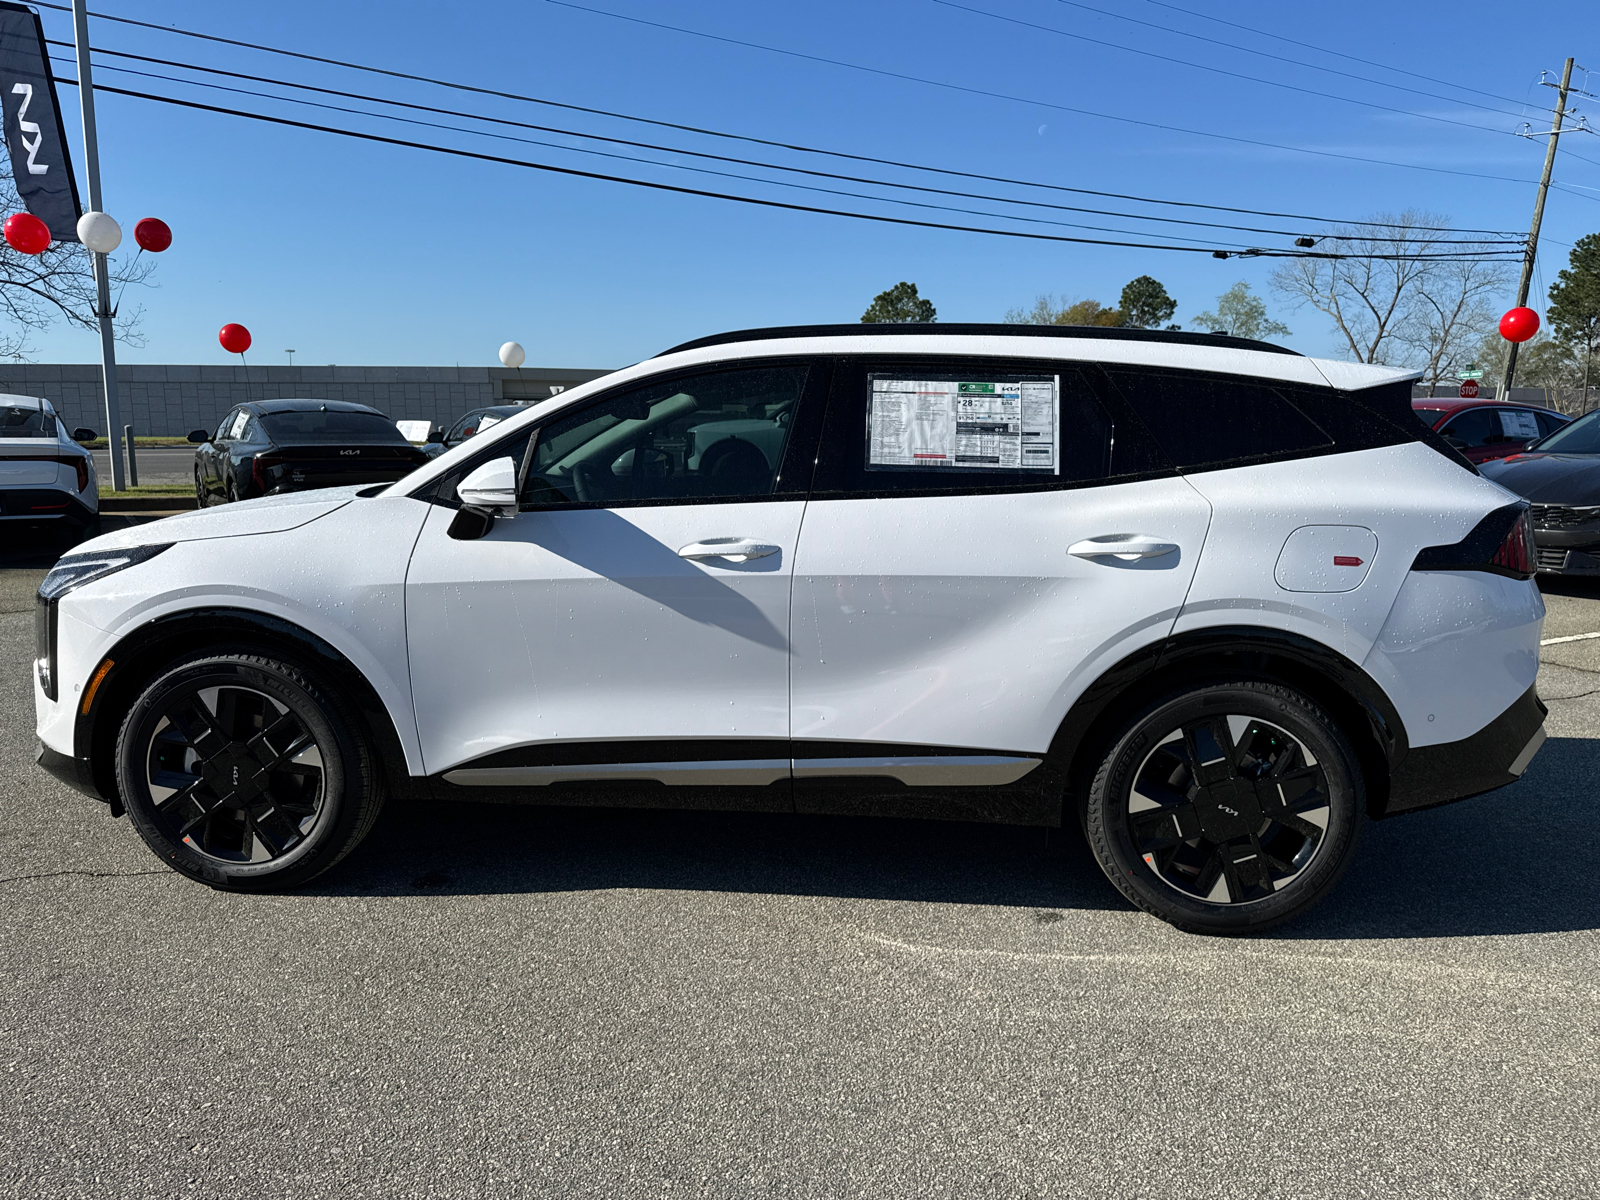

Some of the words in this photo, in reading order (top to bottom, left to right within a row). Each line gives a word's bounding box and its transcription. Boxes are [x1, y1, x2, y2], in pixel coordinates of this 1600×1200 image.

[1461, 386, 1477, 395] STOP
[962, 399, 973, 407] 28
[1110, 734, 1146, 801] MICHELIN
